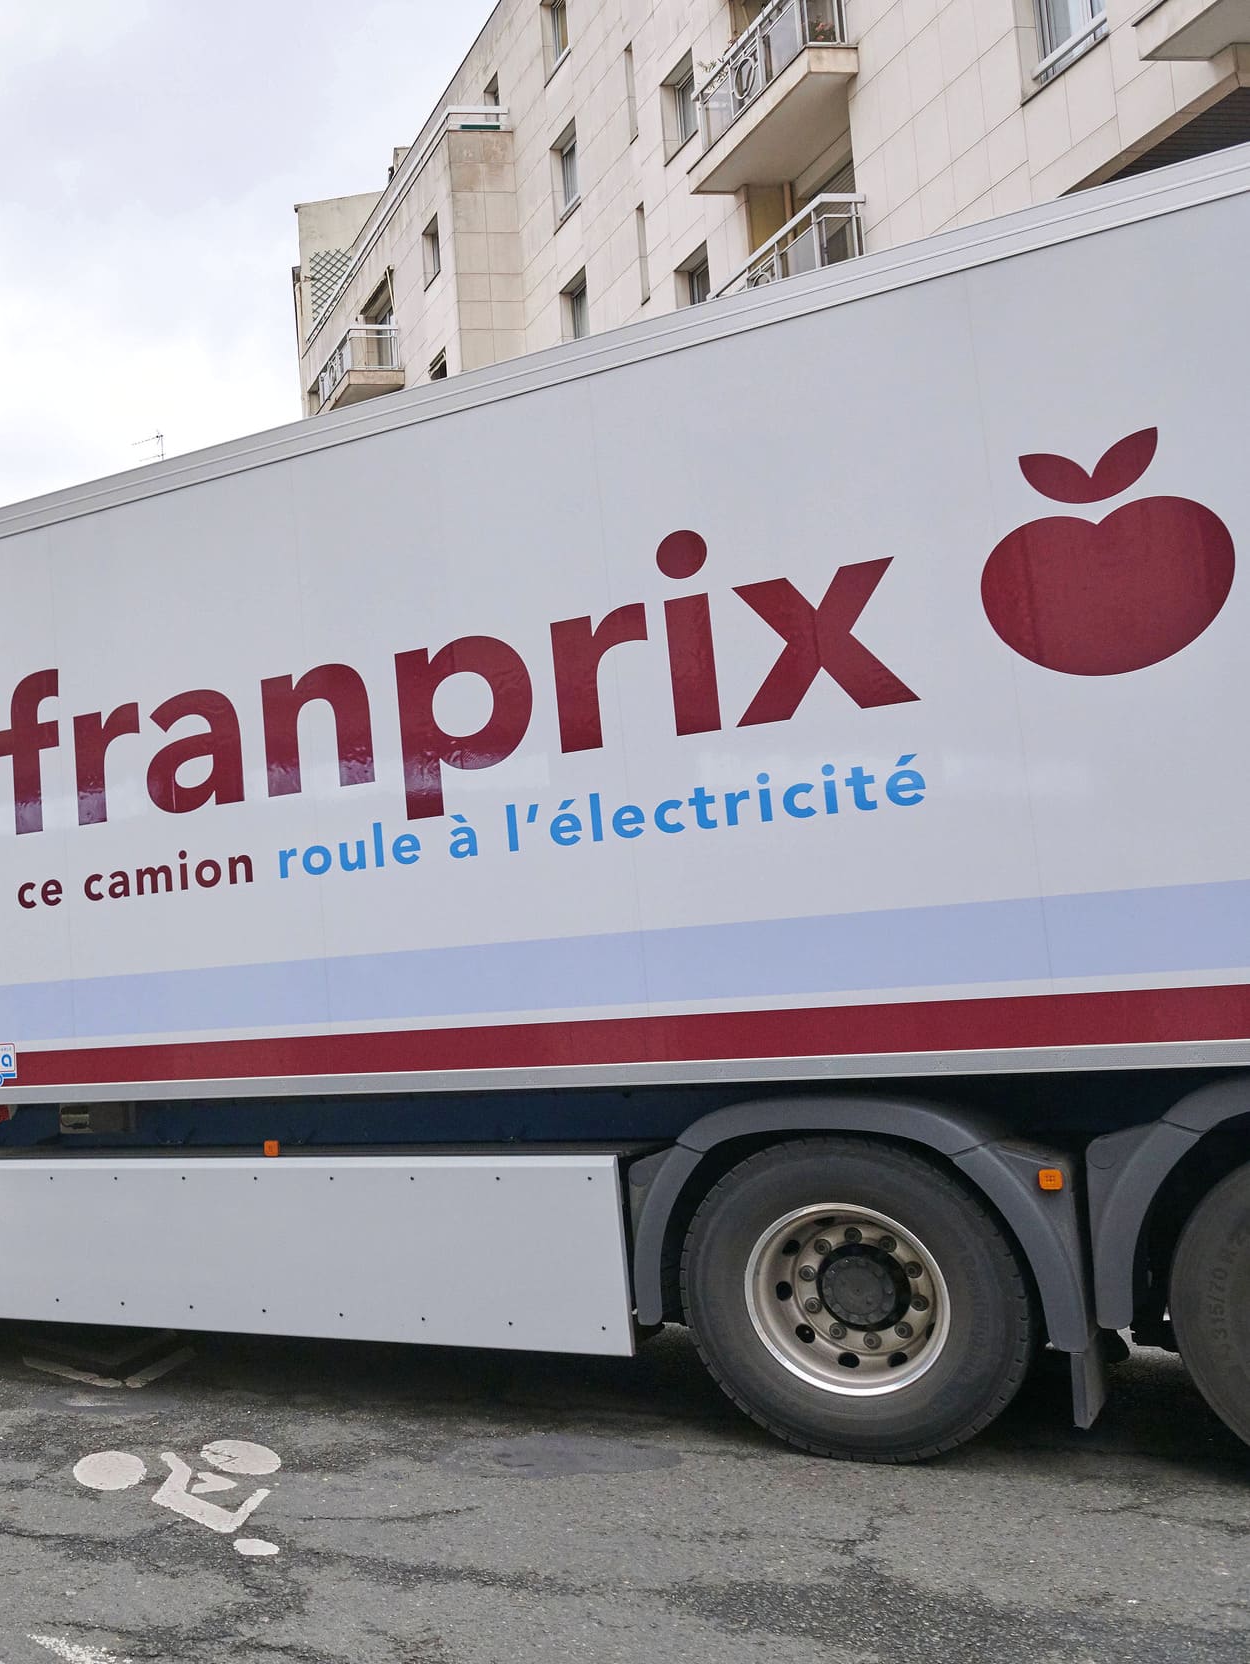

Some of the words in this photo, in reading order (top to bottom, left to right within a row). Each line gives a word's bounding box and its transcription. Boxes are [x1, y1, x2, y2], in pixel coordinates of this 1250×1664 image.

[17, 878, 63, 909] ce
[84, 850, 254, 901] camion
[278, 822, 422, 879] roule
[449, 814, 479, 859] à
